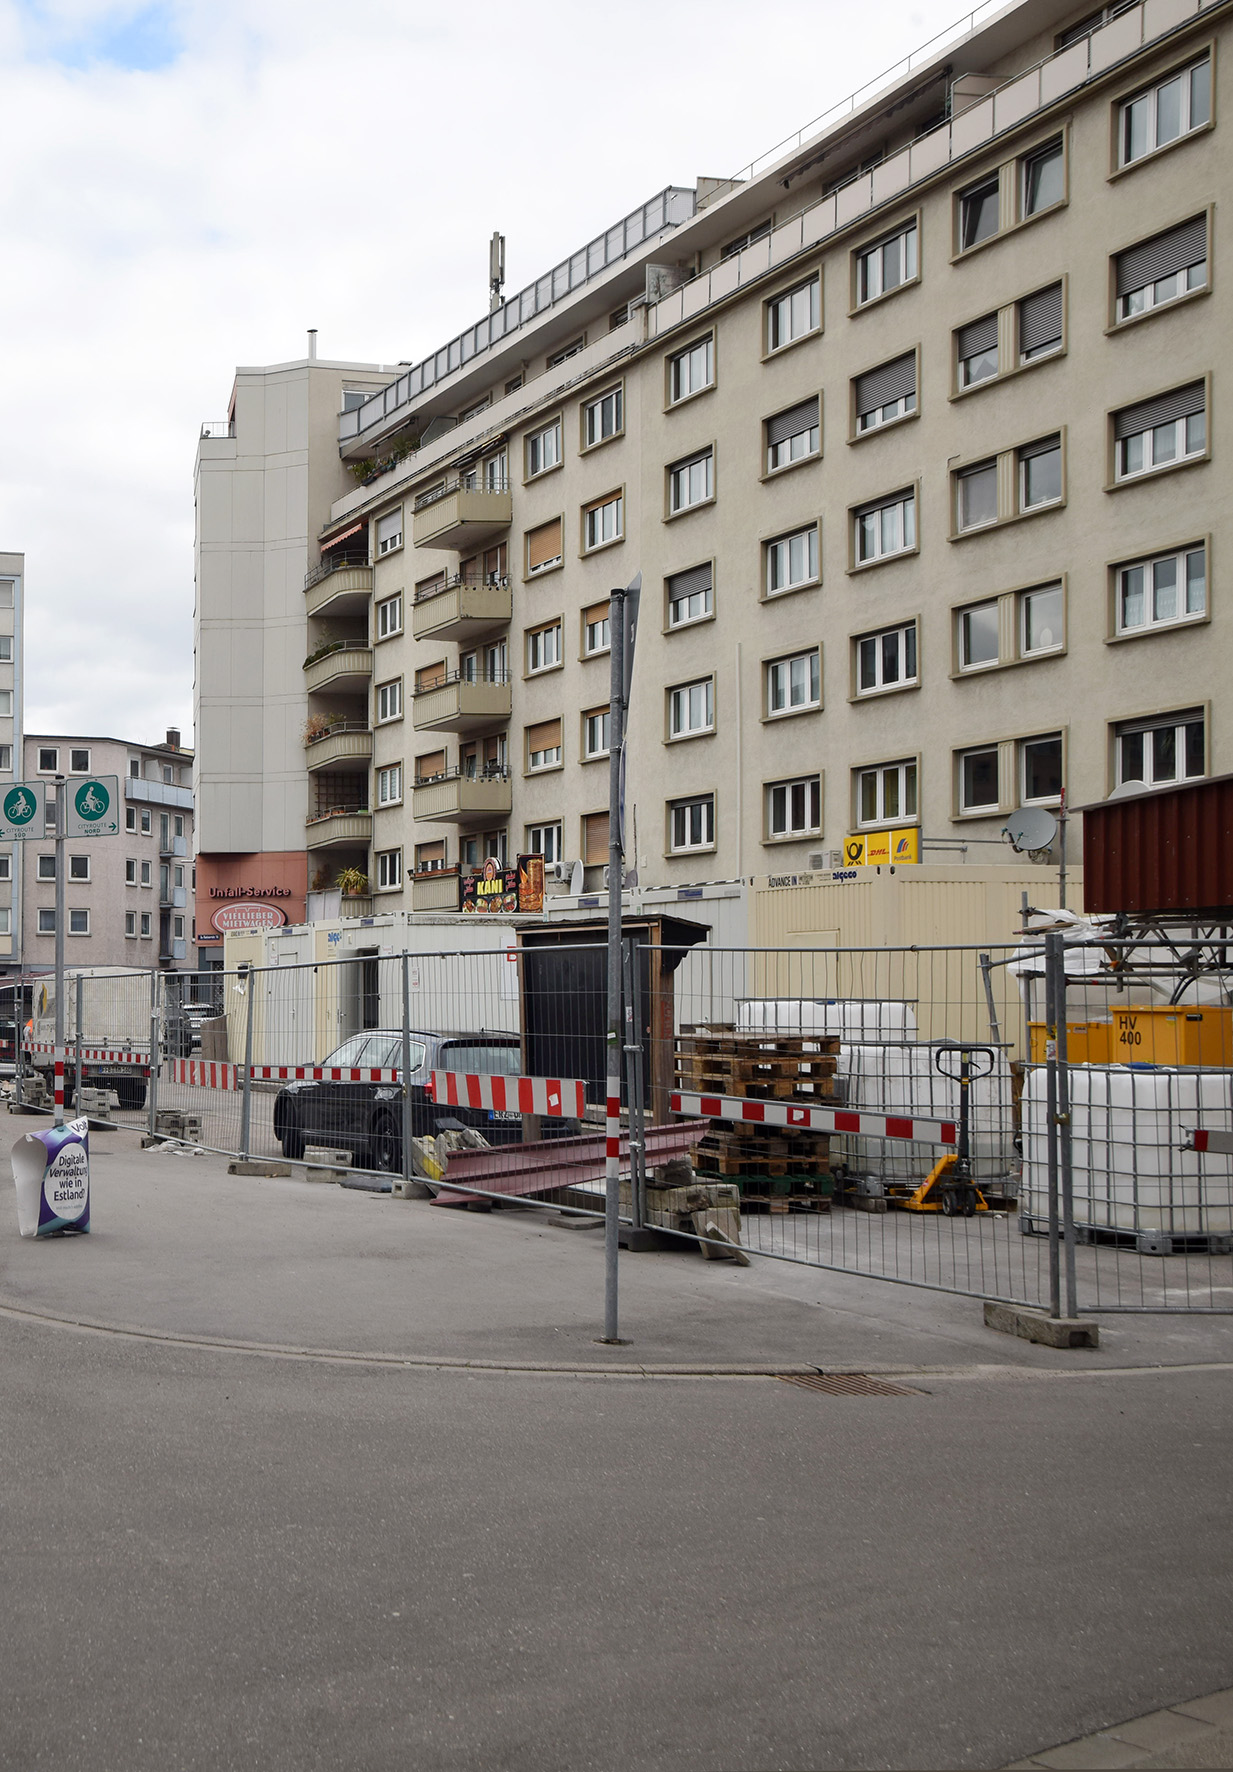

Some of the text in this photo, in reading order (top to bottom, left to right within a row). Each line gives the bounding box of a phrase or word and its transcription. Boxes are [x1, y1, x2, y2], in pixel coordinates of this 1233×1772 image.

[477, 879, 503, 895] KANI
[768, 876, 790, 888] ADVANCE
[791, 876, 797, 885] IN
[208, 886, 290, 898] Unfall-Service
[223, 912, 273, 920] VIELLIEBER
[222, 920, 273, 928] MIETWAGEN
[1119, 1016, 1137, 1030] HV
[1120, 1031, 1142, 1045] 400
[71, 1121, 88, 1132] Volt
[58, 1153, 84, 1168] Digitale
[49, 1166, 88, 1178] Verwaltung
[59, 1177, 82, 1189] wie in
[54, 1188, 85, 1201] Estland?
